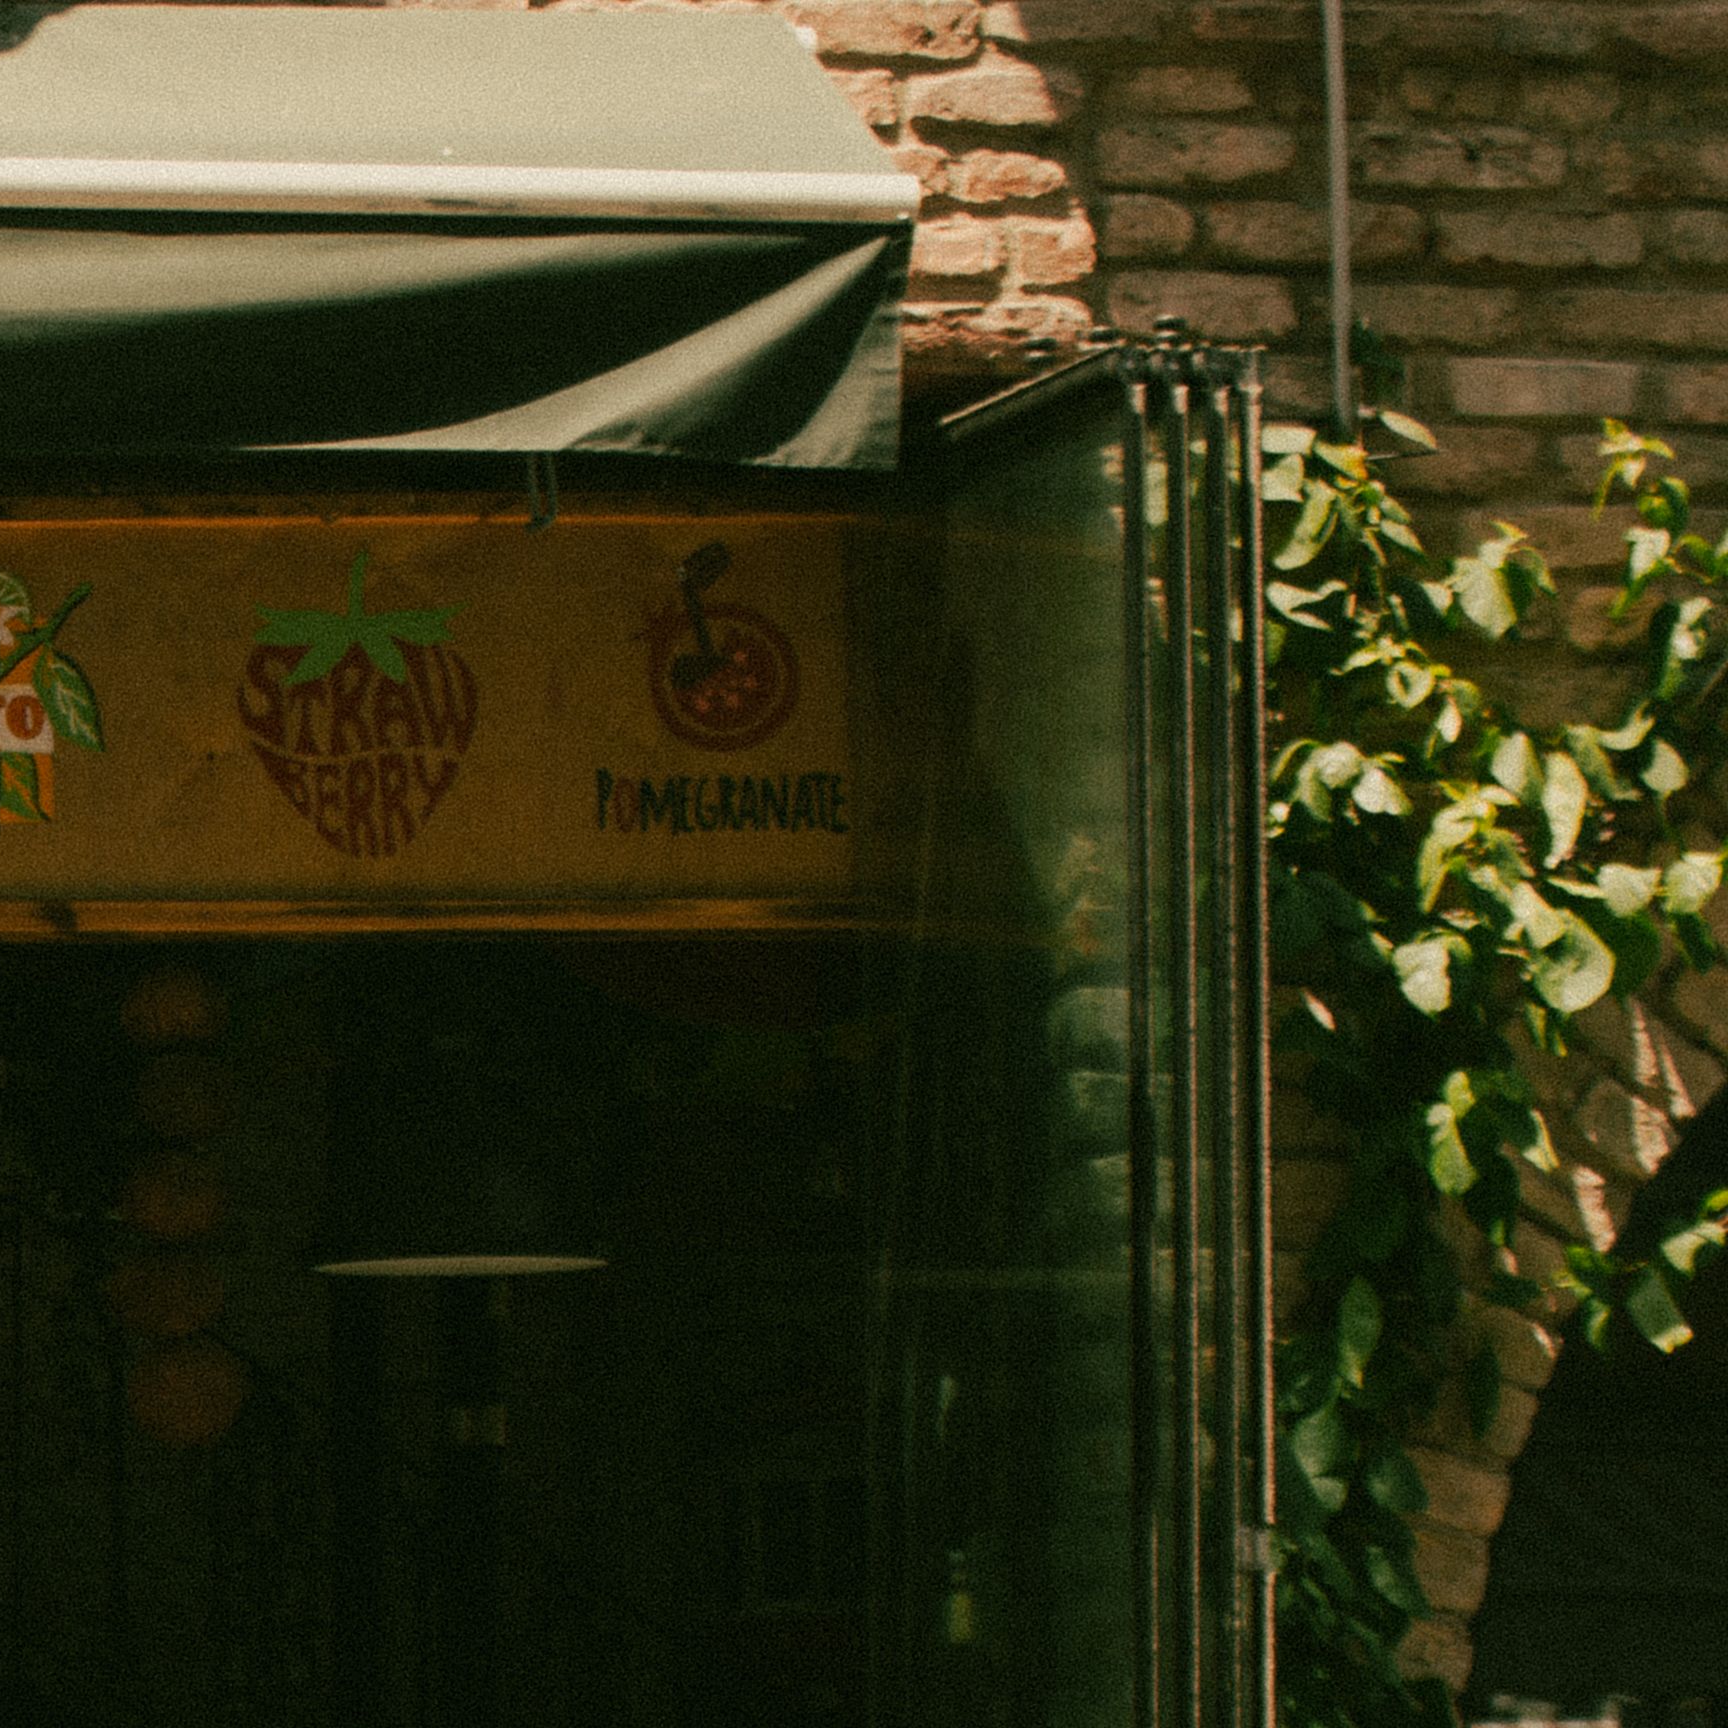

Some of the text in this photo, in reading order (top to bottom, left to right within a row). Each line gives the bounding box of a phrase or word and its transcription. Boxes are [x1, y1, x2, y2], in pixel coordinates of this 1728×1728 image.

[235, 634, 479, 757] STRAW
[248, 738, 460, 860] BERRY
[594, 767, 850, 836] POMEGRANATE
